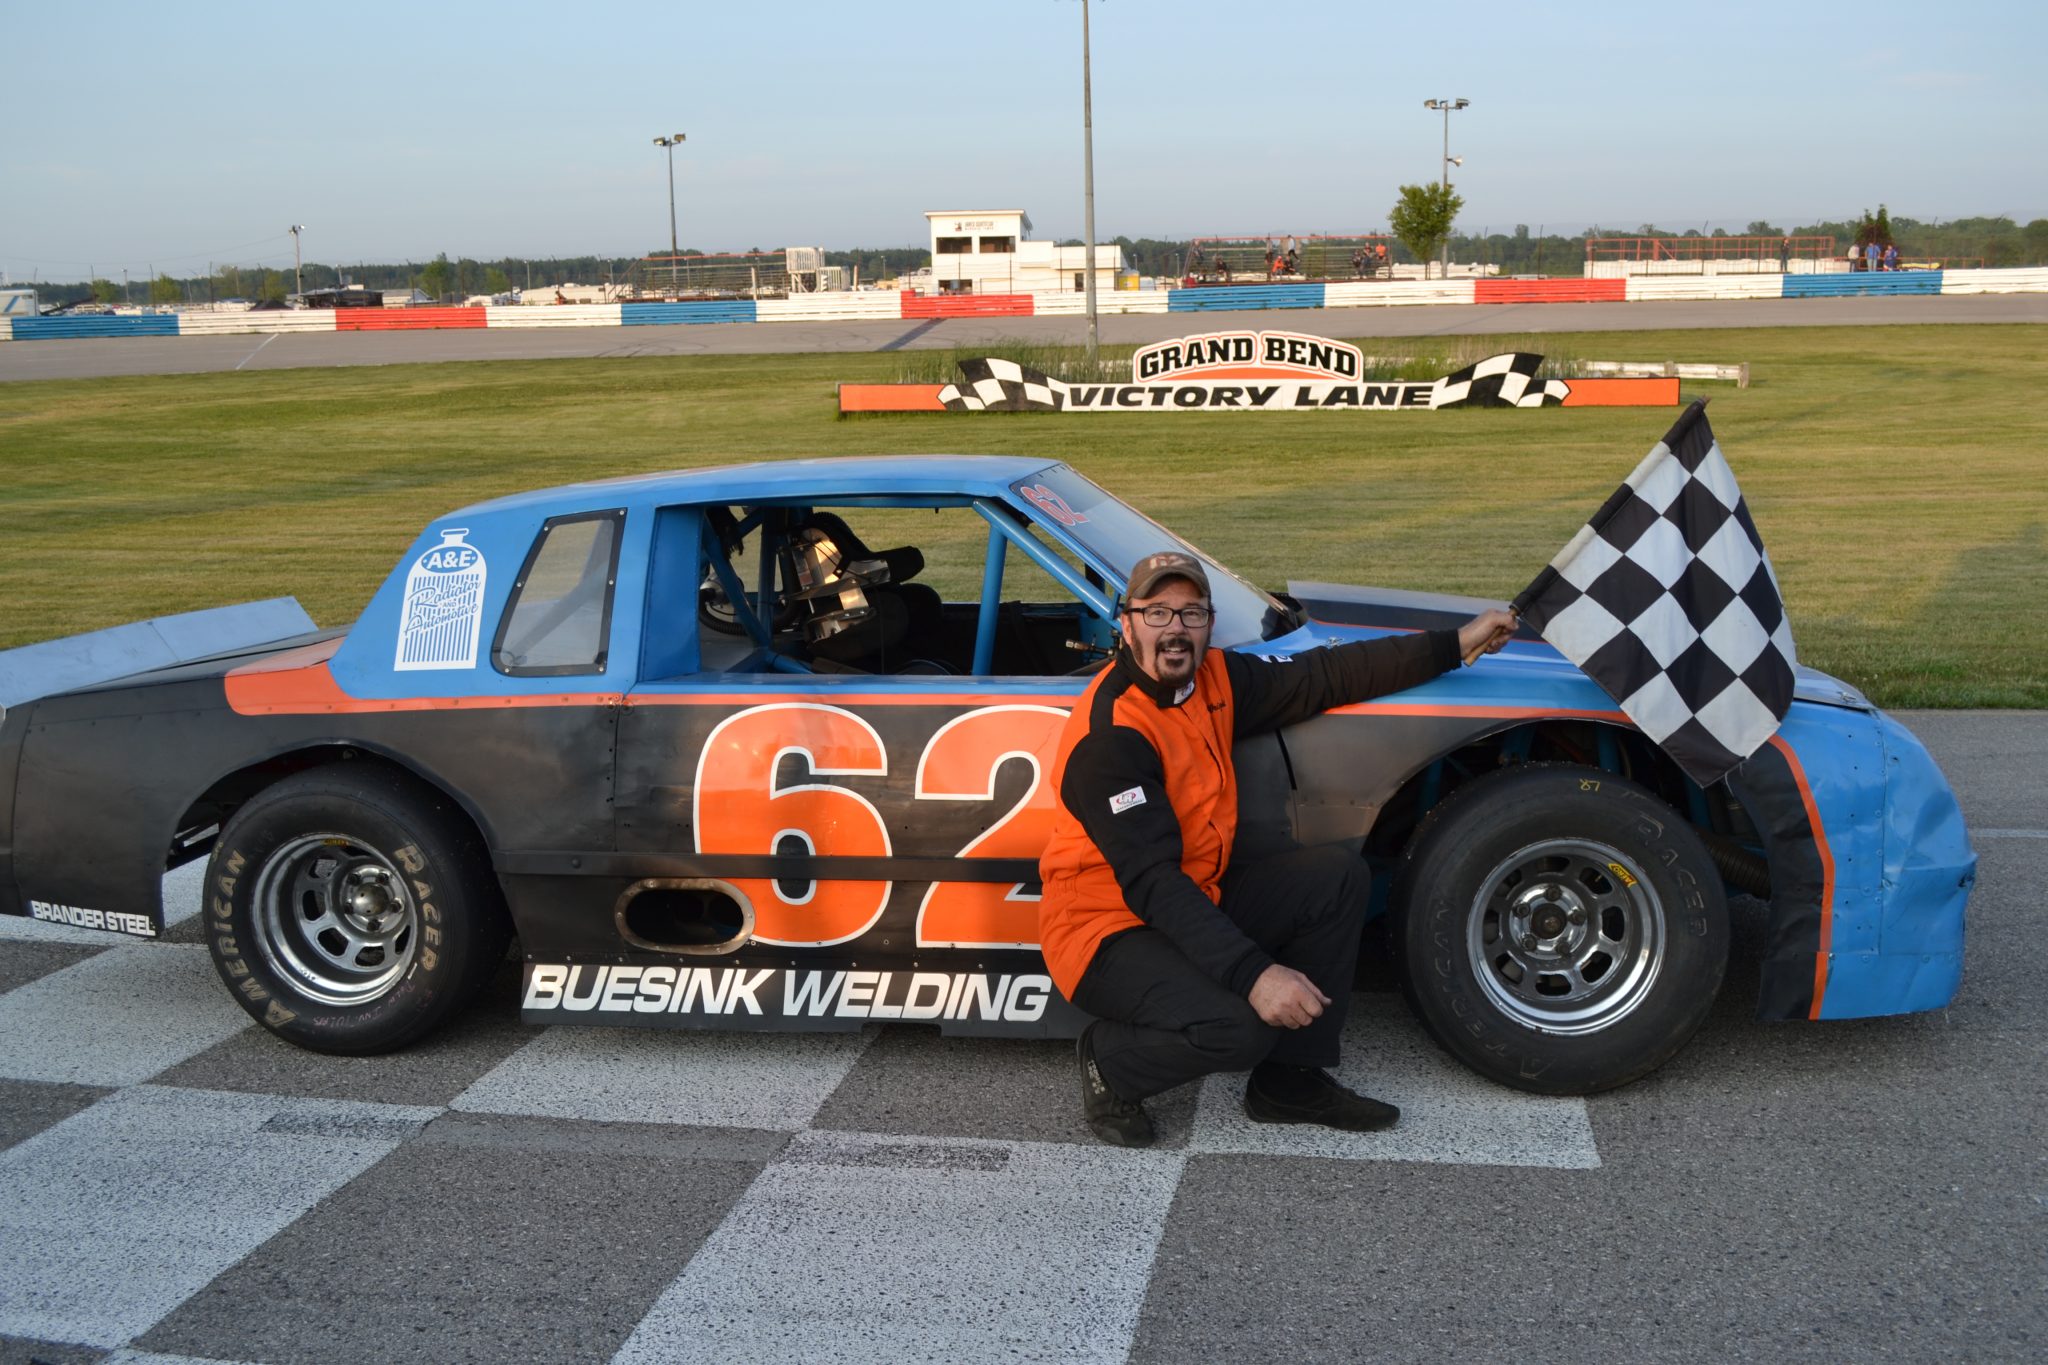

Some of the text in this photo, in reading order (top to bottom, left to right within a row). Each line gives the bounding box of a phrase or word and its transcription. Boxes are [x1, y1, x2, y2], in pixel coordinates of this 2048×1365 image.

[1140, 337, 1356, 379] GRAND BEND
[1069, 386, 1434, 407] VICTORY LANE
[1020, 484, 1089, 526] 62
[426, 550, 473, 569] A&E
[408, 581, 481, 608] Radiator
[404, 603, 479, 636] Automotive
[693, 702, 1073, 949] 62
[31, 900, 156, 937] BRANDER STEEL
[393, 841, 441, 973] RACER
[213, 850, 297, 1028] AMERICAN
[522, 964, 1053, 1022] BUESINK WELDING
